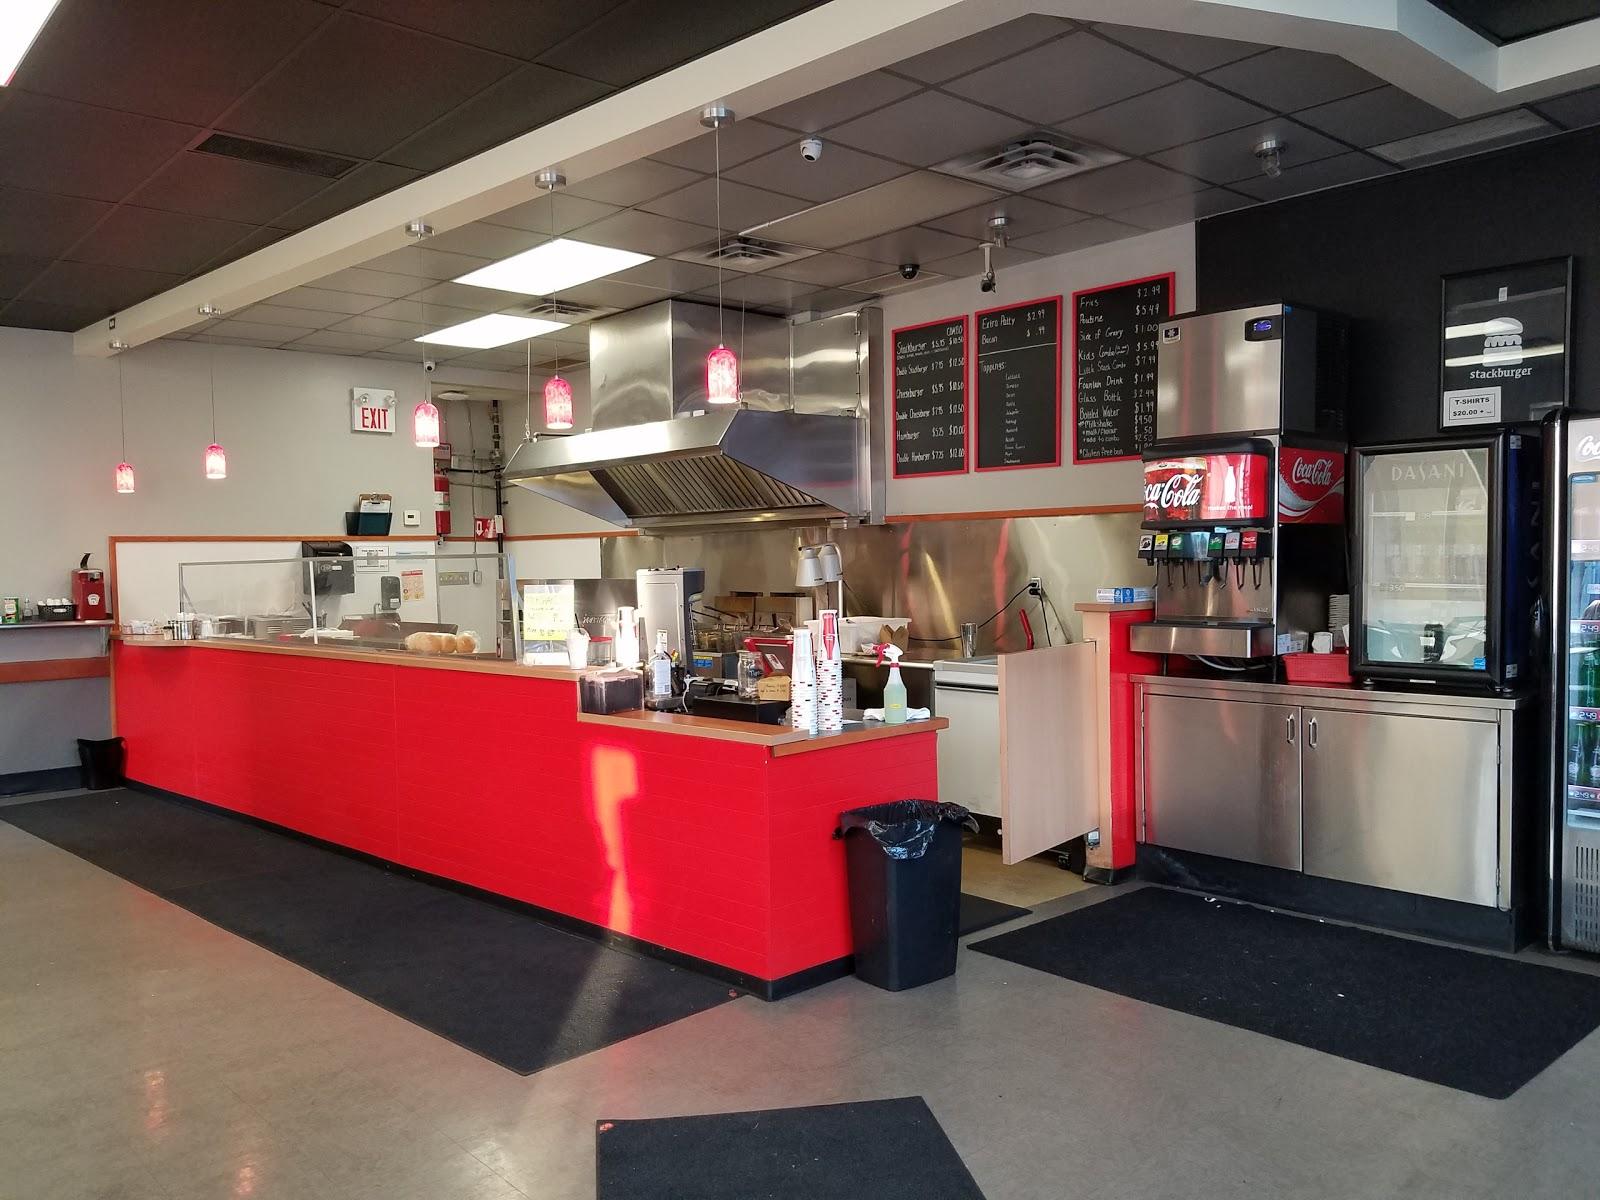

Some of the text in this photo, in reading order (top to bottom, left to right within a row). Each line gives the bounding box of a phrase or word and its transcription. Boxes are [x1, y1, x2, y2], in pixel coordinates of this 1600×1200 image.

[1080, 297, 1099, 307] Fries
[982, 317, 999, 329] Extra
[1000, 315, 1015, 326] Patty
[1080, 313, 1104, 324] Poutine
[946, 325, 962, 336] COMBO
[1080, 330, 1092, 341] Side
[1094, 328, 1102, 340] of
[1105, 326, 1123, 339] Gravy
[981, 334, 998, 345] Bacon
[1079, 349, 1096, 362] Kids
[1470, 368, 1532, 379] stackburger
[1107, 375, 1124, 386] Drink
[1078, 391, 1097, 402] Glass
[1104, 390, 1122, 402] Bottle
[1455, 397, 1490, 405] T-SHIRTS
[361, 407, 388, 429] EXIT
[1080, 407, 1099, 420] Bottled
[1102, 406, 1120, 417] Water
[1292, 457, 1333, 485] Coca-Cola
[1391, 463, 1464, 481] DASANI
[1581, 624, 1599, 633] 2.49
[1579, 711, 1597, 719] 2.49
